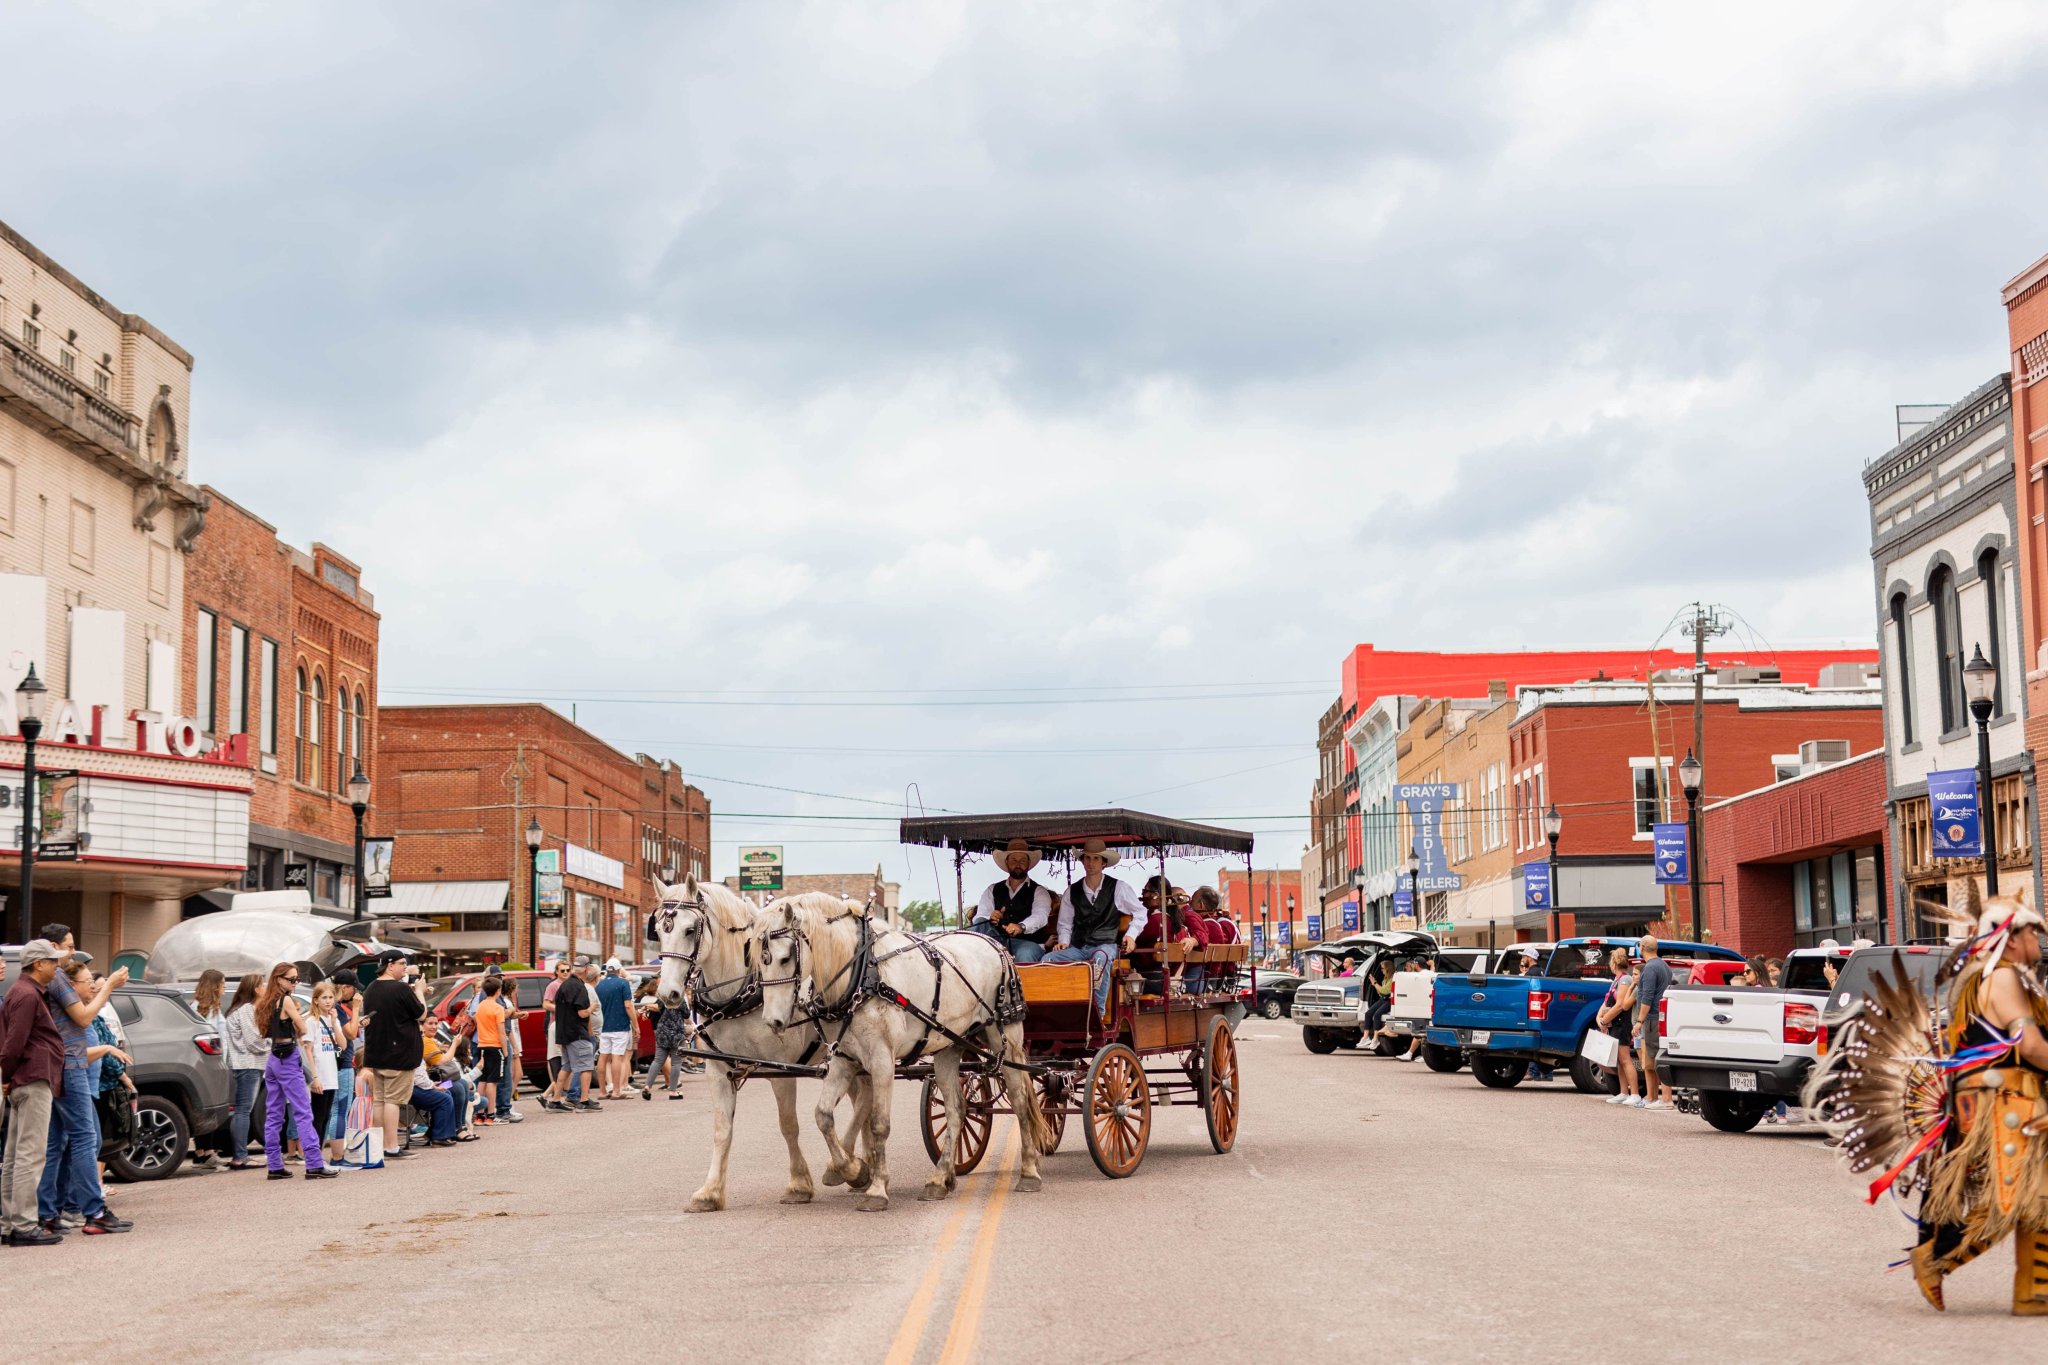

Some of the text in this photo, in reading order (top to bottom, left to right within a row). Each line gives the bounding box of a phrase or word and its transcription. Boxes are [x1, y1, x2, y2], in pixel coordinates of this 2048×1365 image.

[0, 690, 201, 758] ALTO
[1400, 785, 1450, 798] GRAY'S
[1935, 792, 1974, 800] Welcome
[1421, 801, 1433, 874] CREDIT
[1400, 876, 1460, 890] JEWELERS
